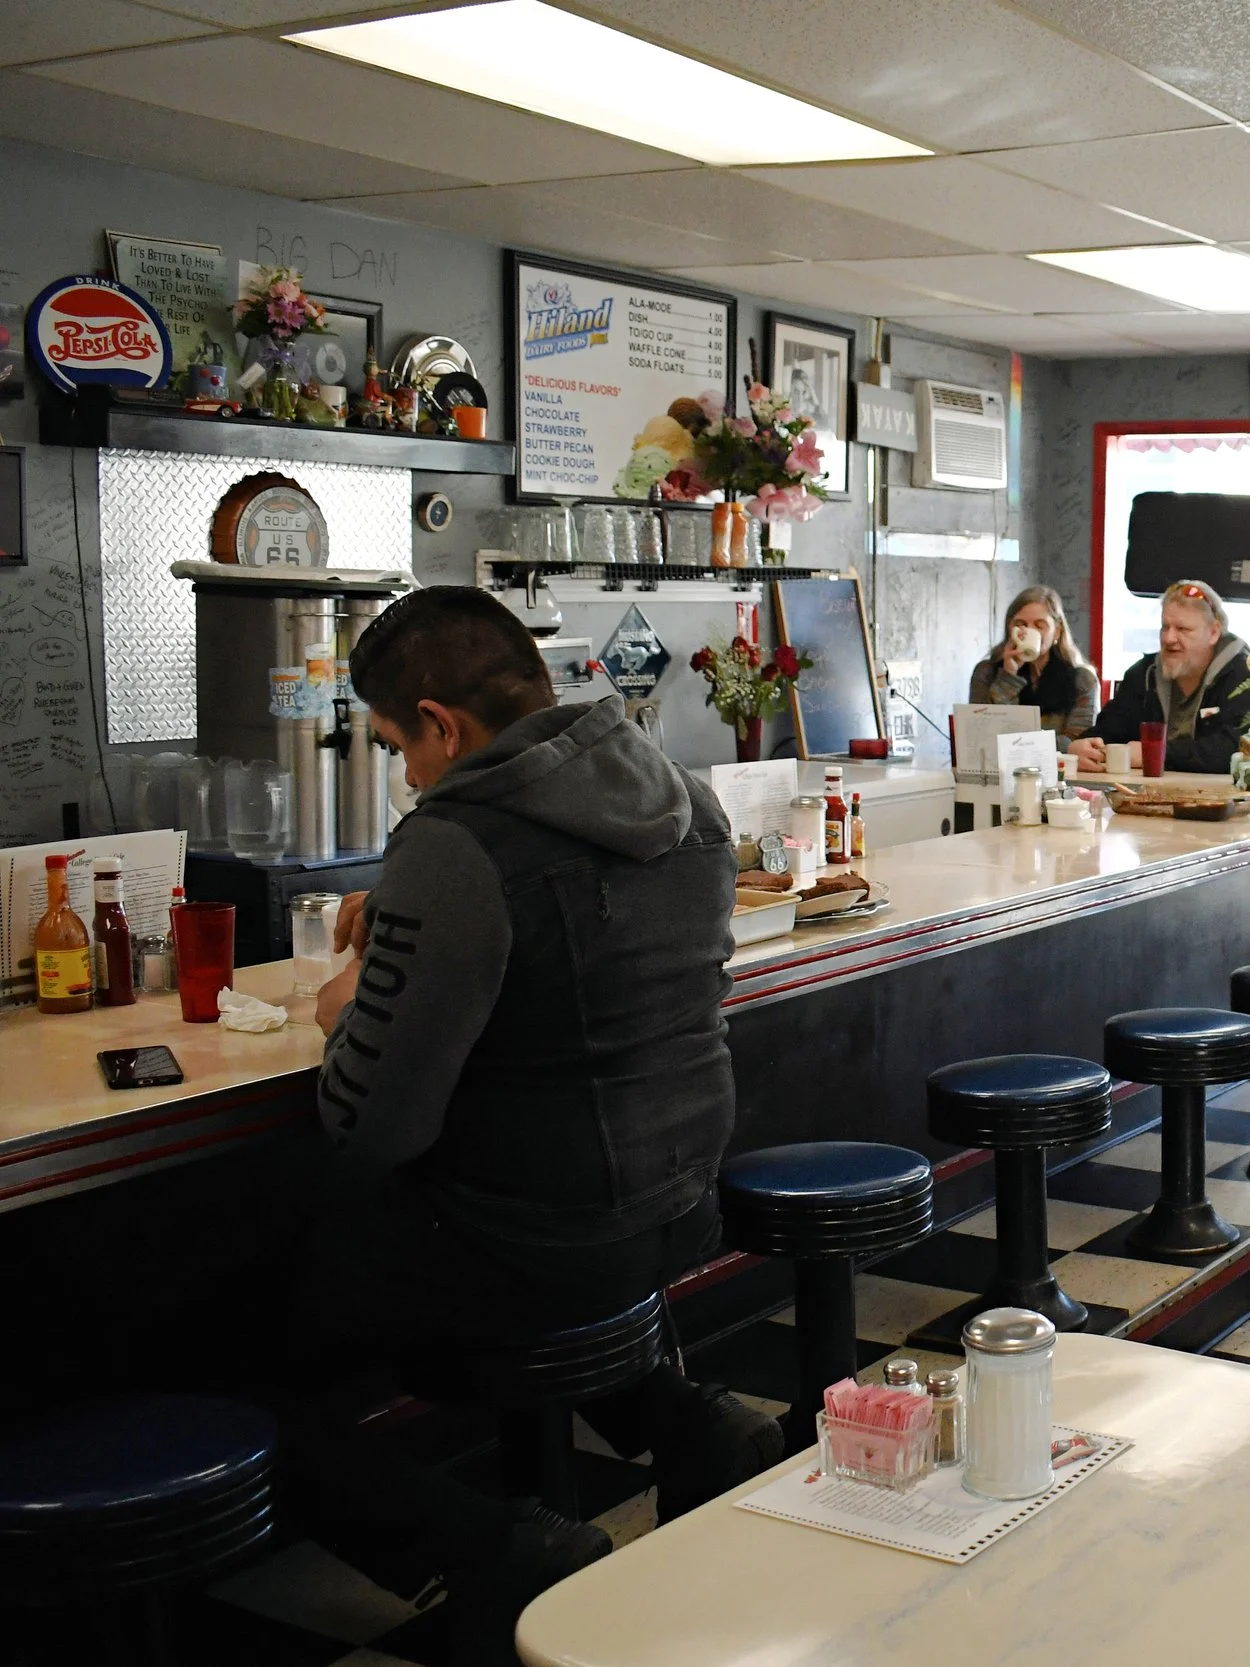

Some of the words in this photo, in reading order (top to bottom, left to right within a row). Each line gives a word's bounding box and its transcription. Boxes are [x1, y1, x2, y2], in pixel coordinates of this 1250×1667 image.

[147, 248, 177, 264] BETTER
[181, 254, 193, 266] TO
[195, 257, 215, 270] HAVE
[255, 226, 309, 275] BIG
[330, 242, 398, 287] DAN
[141, 262, 171, 277] LOVED
[175, 268, 182, 279] &
[186, 269, 209, 282] LOST
[76, 277, 121, 291] DRINK
[135, 275, 158, 288] THAN
[161, 279, 173, 291] TO
[176, 282, 192, 294] LIVE
[194, 284, 216, 296] WITH
[149, 291, 166, 305] THE
[170, 294, 209, 310] PSYCHO
[167, 308, 189, 321] REST
[525, 298, 614, 342] Hiland
[628, 312, 649, 324] DISH
[174, 323, 191, 336] LIFE
[656, 331, 673, 342] CUP
[525, 343, 555, 358] DAIRY
[557, 337, 587, 352] FOODS
[628, 342, 661, 356] WAFFLE
[663, 347, 686, 360] CONE
[628, 356, 651, 369] SODA
[654, 360, 685, 374] FLOATS
[525, 391, 563, 405] VANILLA
[525, 406, 580, 422] CHOCOLATE
[861, 403, 915, 437] KAYAK
[525, 422, 588, 438] STRAWBERRY
[525, 438, 562, 452] BUTTER
[564, 441, 594, 454] PECAN
[525, 454, 561, 467] COOKIE
[563, 456, 595, 469] DOUGH
[525, 469, 547, 481] MINT
[549, 470, 599, 485] CHOC-CHIP
[264, 515, 302, 528] ROUTE
[275, 682, 296, 694] ICED
[278, 695, 296, 707] TEA
[769, 857, 784, 872] 66
